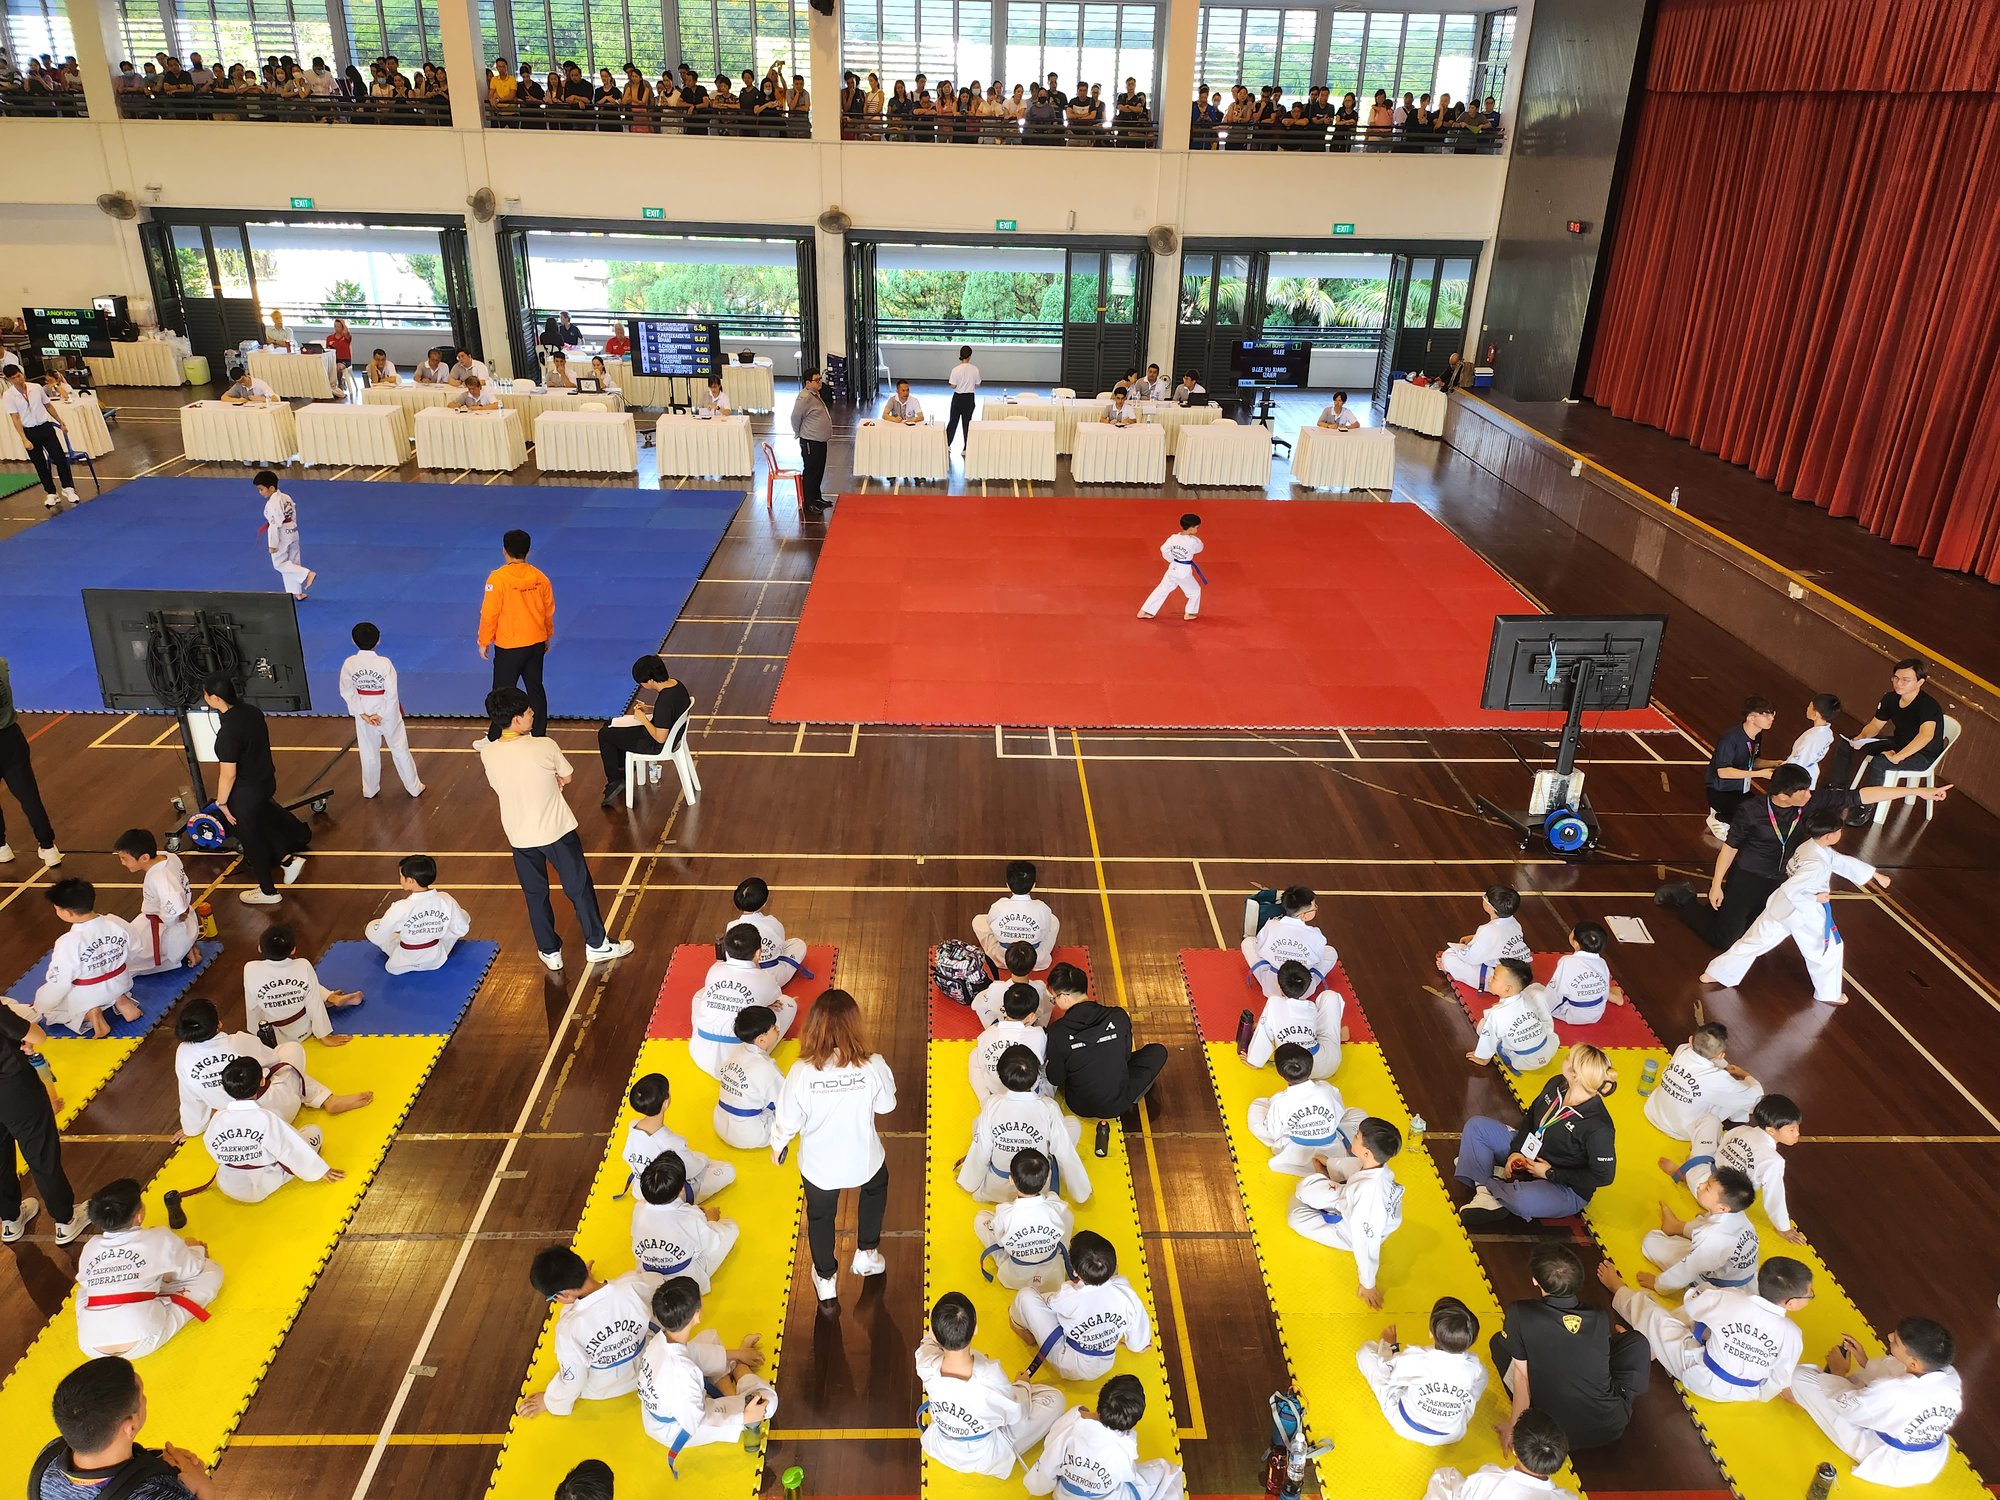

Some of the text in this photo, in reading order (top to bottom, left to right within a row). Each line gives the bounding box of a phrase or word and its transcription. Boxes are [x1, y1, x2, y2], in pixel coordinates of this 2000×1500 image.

[294, 199, 308, 208] EXIT
[646, 209, 660, 218] EXIT
[999, 221, 1013, 230] EXIT
[1336, 225, 1350, 233] EXIT
[403, 909, 449, 929] SINGAPORE
[998, 913, 1041, 932] SINGAPORE
[408, 926, 444, 936] FEDERATIO
[1000, 931, 1036, 940] FEDERATION
[80, 935, 127, 964] SINGAPORE
[1270, 938, 1311, 958] SINGAPORE
[257, 978, 309, 1001] SINGAPORE
[267, 990, 302, 1001] TAEKWONDO
[707, 980, 755, 1005] SINGAPORE
[263, 995, 306, 1009] FEDERATIO
[706, 1000, 747, 1013] FEDERATIO
[190, 1053, 236, 1081] SINGAPO
[1287, 1104, 1335, 1130] SINGAPORE
[211, 1128, 264, 1150] SINGAPOR
[991, 1121, 1044, 1144] SINGAPORE
[999, 1136, 1033, 1145] TAEKWONDO
[220, 1144, 258, 1153] TAEKWONDO
[1006, 1224, 1062, 1248] SINGAPORE
[1017, 1238, 1052, 1250] TAEKWONDO
[634, 1238, 686, 1259] SINGAPORE
[1010, 1243, 1057, 1258] FEDERATION
[92, 1263, 133, 1276] TAEKWONDO
[1070, 1312, 1127, 1341] SINGAPORE
[592, 1334, 633, 1359] AEKWONDO
[1064, 1468, 1102, 1490] TAEKWONDO
